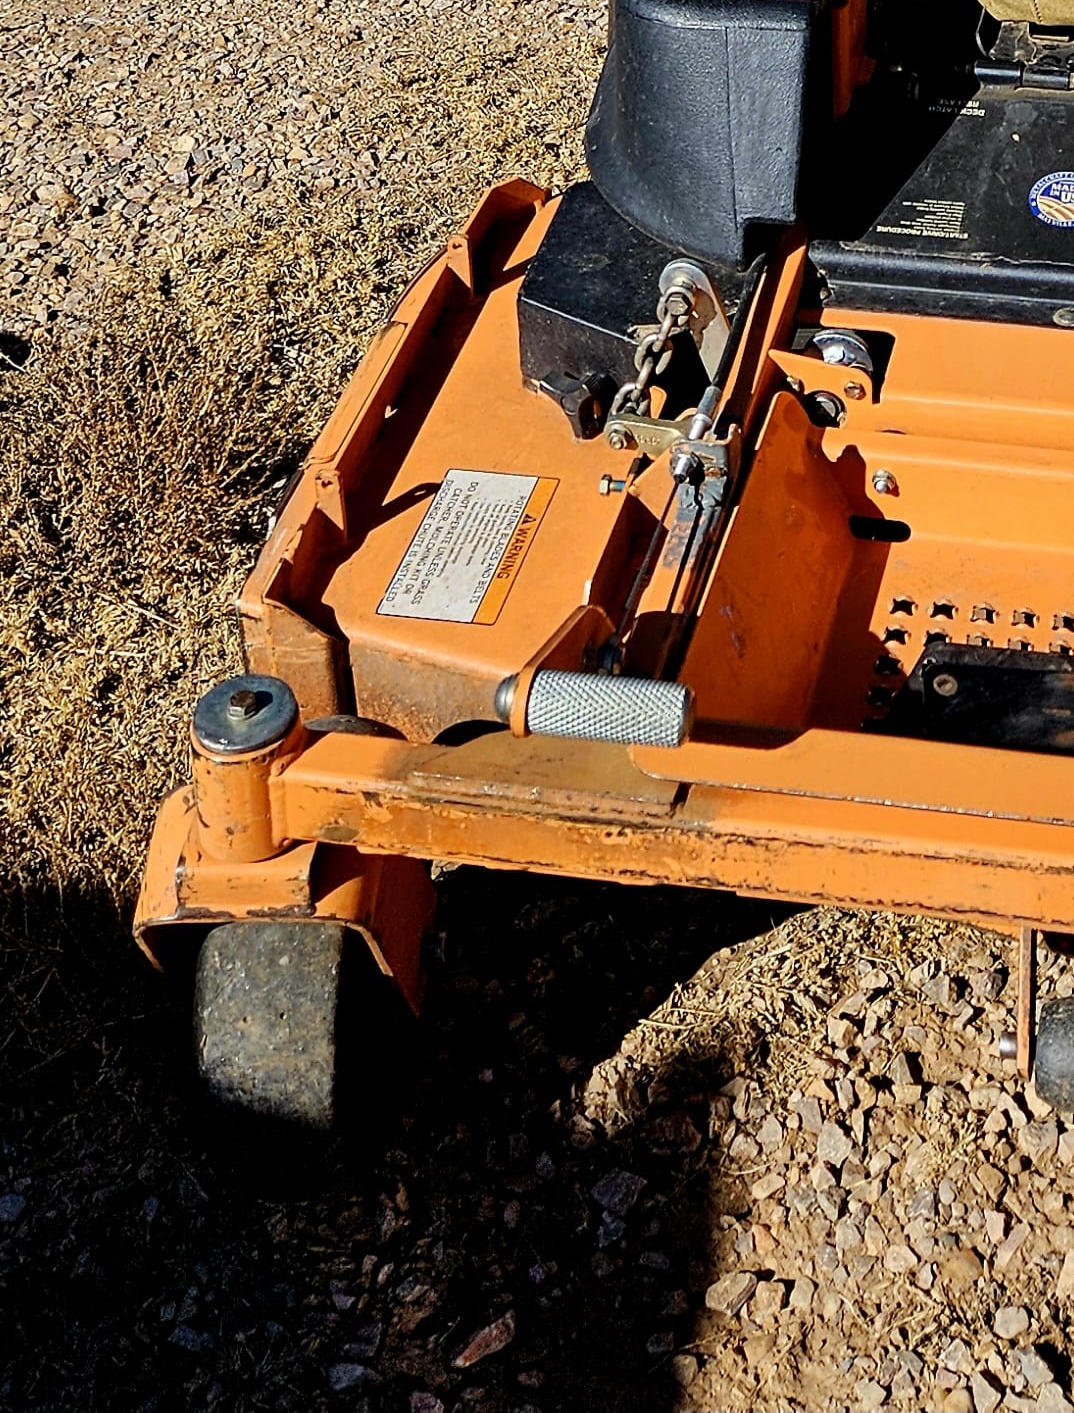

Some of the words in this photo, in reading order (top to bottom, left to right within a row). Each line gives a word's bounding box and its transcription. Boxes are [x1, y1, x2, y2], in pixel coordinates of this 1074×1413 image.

[426, 479, 453, 520] DISCHARGE
[465, 481, 478, 493] DO
[458, 494, 472, 508] NOT
[412, 522, 432, 547] CHUTE
[440, 510, 464, 545] OPERATE
[407, 550, 419, 558] IS
[489, 532, 509, 560] BLADES
[495, 527, 530, 579] WARNING
[408, 568, 422, 581] KIT
[424, 546, 446, 577] UNLESS
[480, 562, 495, 578] AND
[384, 559, 413, 602] INSTALLED
[410, 578, 431, 605] GRASS
[468, 580, 486, 603] BELTS
